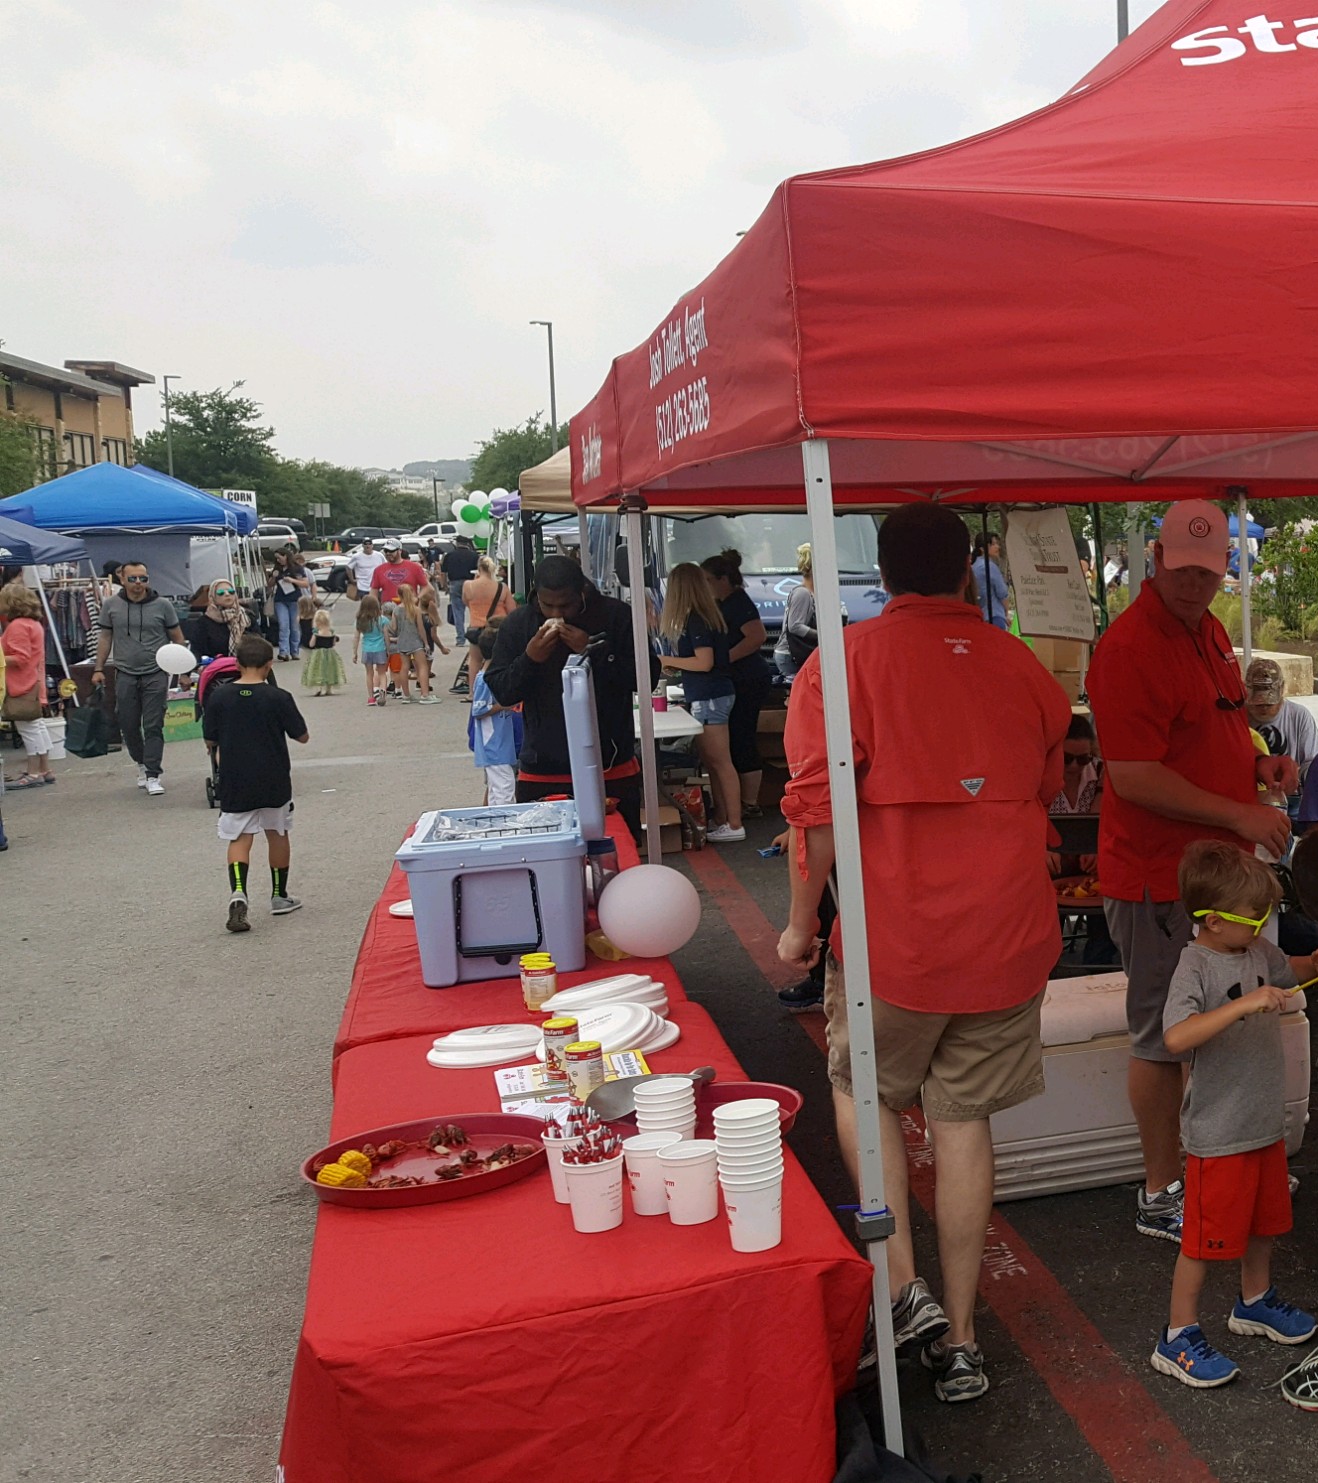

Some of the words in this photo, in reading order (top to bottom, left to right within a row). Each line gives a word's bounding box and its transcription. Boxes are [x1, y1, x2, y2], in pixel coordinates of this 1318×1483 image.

[649, 336, 663, 389] Josh
[686, 297, 709, 367] Agent
[655, 395, 675, 461] (512)
[673, 376, 711, 442] 263-5685
[227, 492, 252, 502] CORN
